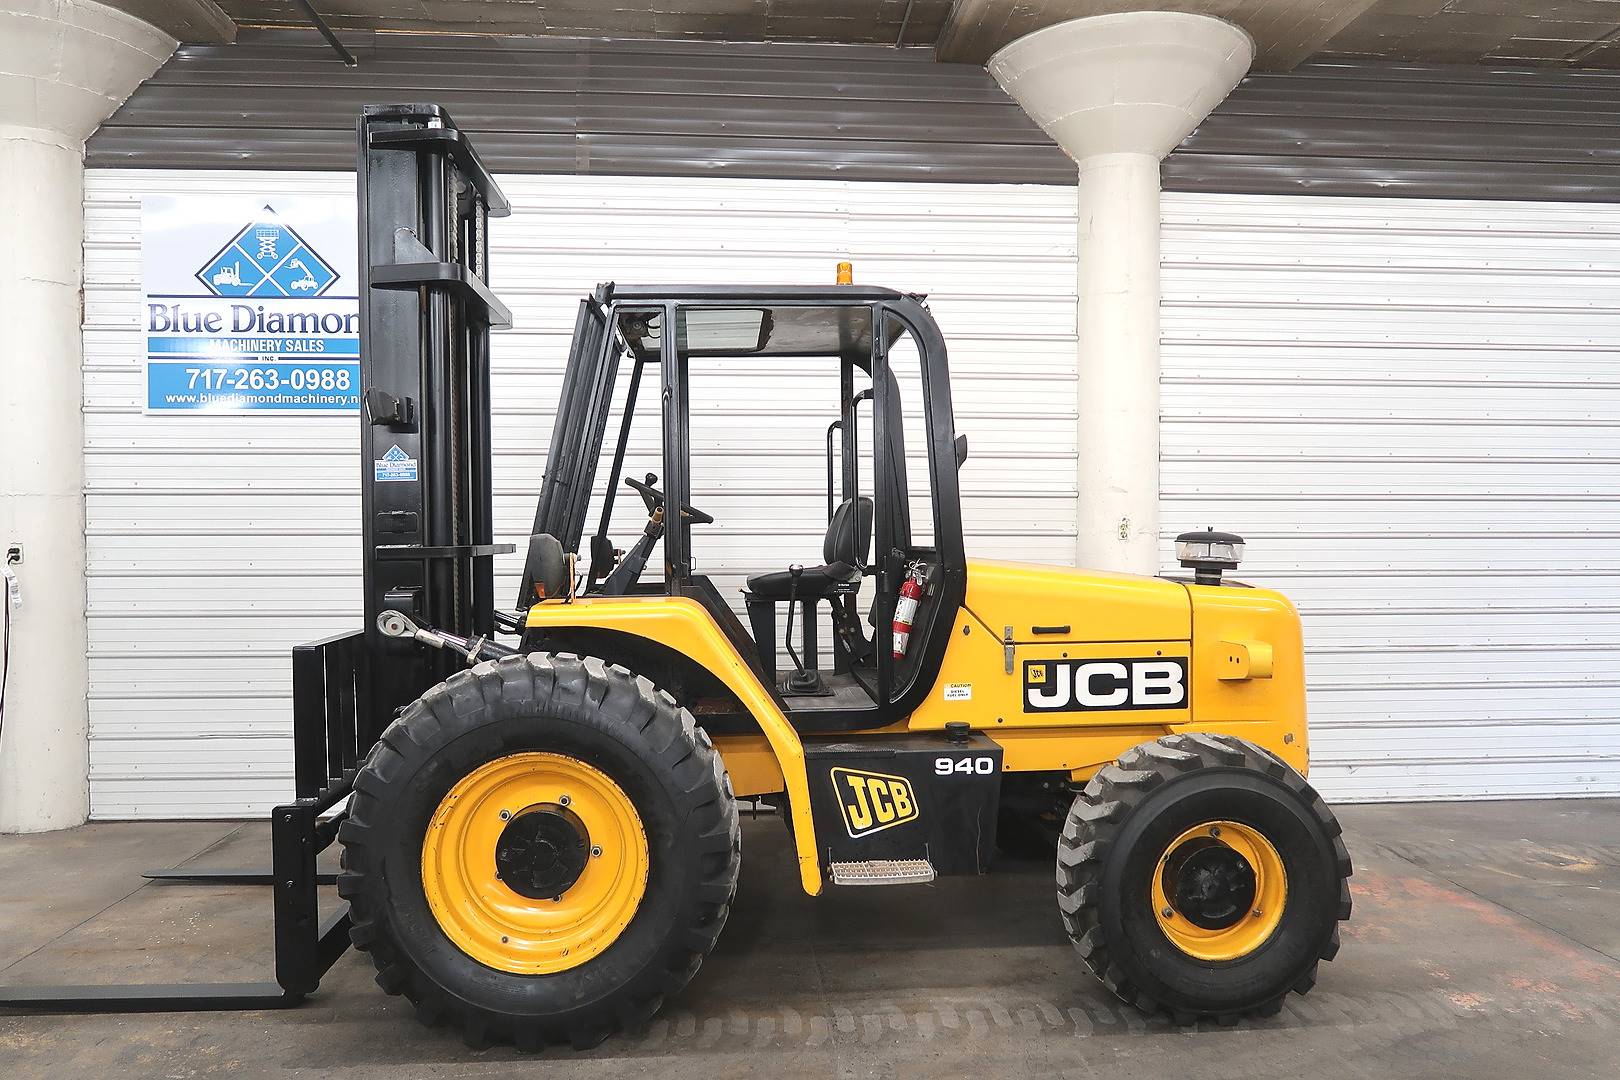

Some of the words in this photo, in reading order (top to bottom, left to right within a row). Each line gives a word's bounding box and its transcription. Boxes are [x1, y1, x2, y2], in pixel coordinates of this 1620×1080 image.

[147, 303, 223, 333] Blue
[230, 304, 360, 334] Diamon
[208, 338, 283, 352] MACHINERY
[285, 339, 325, 352] SALES
[184, 368, 351, 390] 717-263-0988
[165, 392, 360, 406] www.bluediamondmachinery.n
[1027, 661, 1185, 708] JCB
[934, 757, 994, 775] 940
[846, 774, 913, 830] JCB
